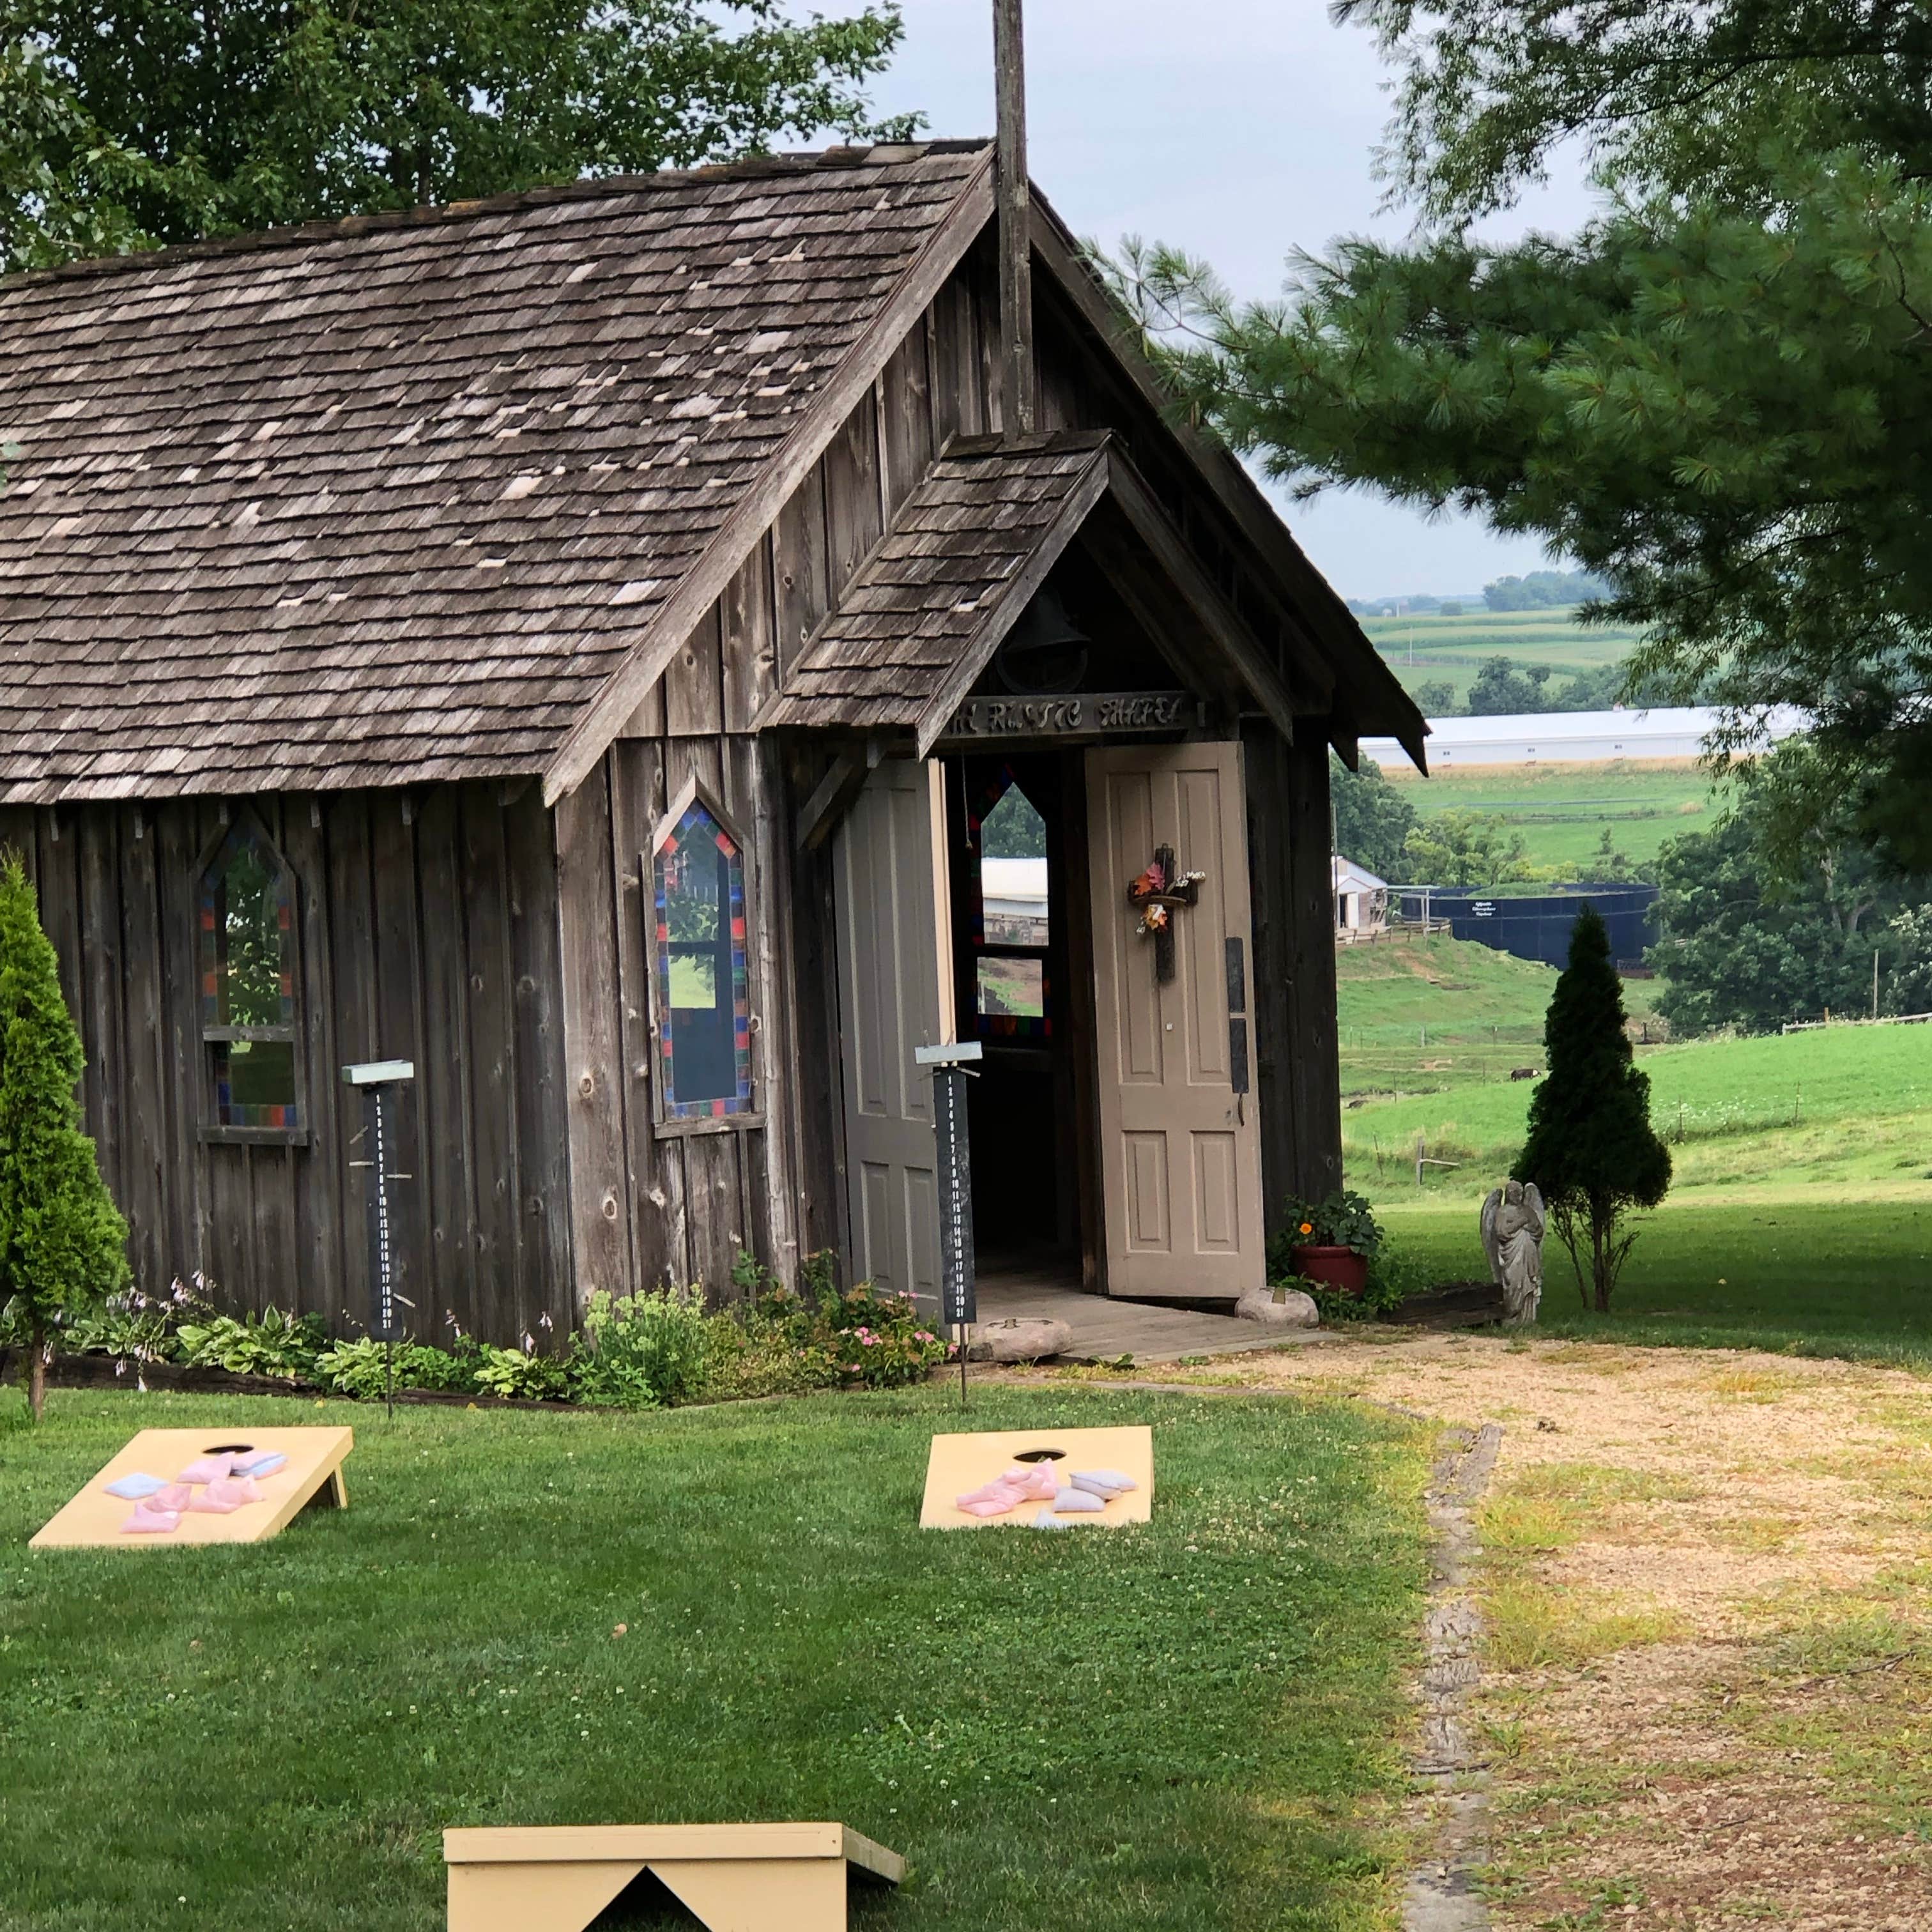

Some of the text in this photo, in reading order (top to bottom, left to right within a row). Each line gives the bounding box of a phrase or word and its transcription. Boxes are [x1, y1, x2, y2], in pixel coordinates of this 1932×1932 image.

[949, 1075, 951, 1085] 1
[948, 1087, 953, 1096] 2
[376, 1094, 379, 1103] 1
[949, 1098, 953, 1108] 3
[376, 1106, 381, 1116] 2
[949, 1110, 953, 1119] 4
[378, 1117, 381, 1128] 3
[950, 1121, 954, 1131] 5
[378, 1130, 382, 1138] 4
[951, 1133, 954, 1143] 6
[378, 1140, 383, 1150] 5
[951, 1144, 955, 1154] 7
[378, 1152, 383, 1162] 6
[951, 1156, 956, 1166] 8
[379, 1163, 383, 1173] 7
[952, 1168, 956, 1177] 9
[379, 1174, 383, 1184] 8
[952, 1179, 959, 1188] 10
[379, 1185, 384, 1195] 9
[953, 1191, 959, 1200] 11
[379, 1196, 387, 1206] 10
[379, 1208, 386, 1217] 11
[953, 1203, 960, 1213] 12
[380, 1218, 388, 1228] 12
[954, 1215, 961, 1224] 13
[381, 1230, 388, 1239] 13
[954, 1227, 961, 1236] 14
[381, 1241, 388, 1250] 14
[954, 1238, 962, 1247] 15
[381, 1252, 388, 1261] 15
[955, 1250, 962, 1259] 16
[381, 1263, 390, 1273] 16
[956, 1261, 963, 1271] 17
[382, 1274, 390, 1284] 17
[956, 1273, 963, 1282] 18
[383, 1286, 390, 1295] 18
[956, 1285, 963, 1294] 19
[383, 1297, 391, 1307] 19
[956, 1296, 965, 1306] 20
[383, 1308, 392, 1317] 20
[956, 1308, 963, 1317] 21
[383, 1319, 391, 1329] 21
